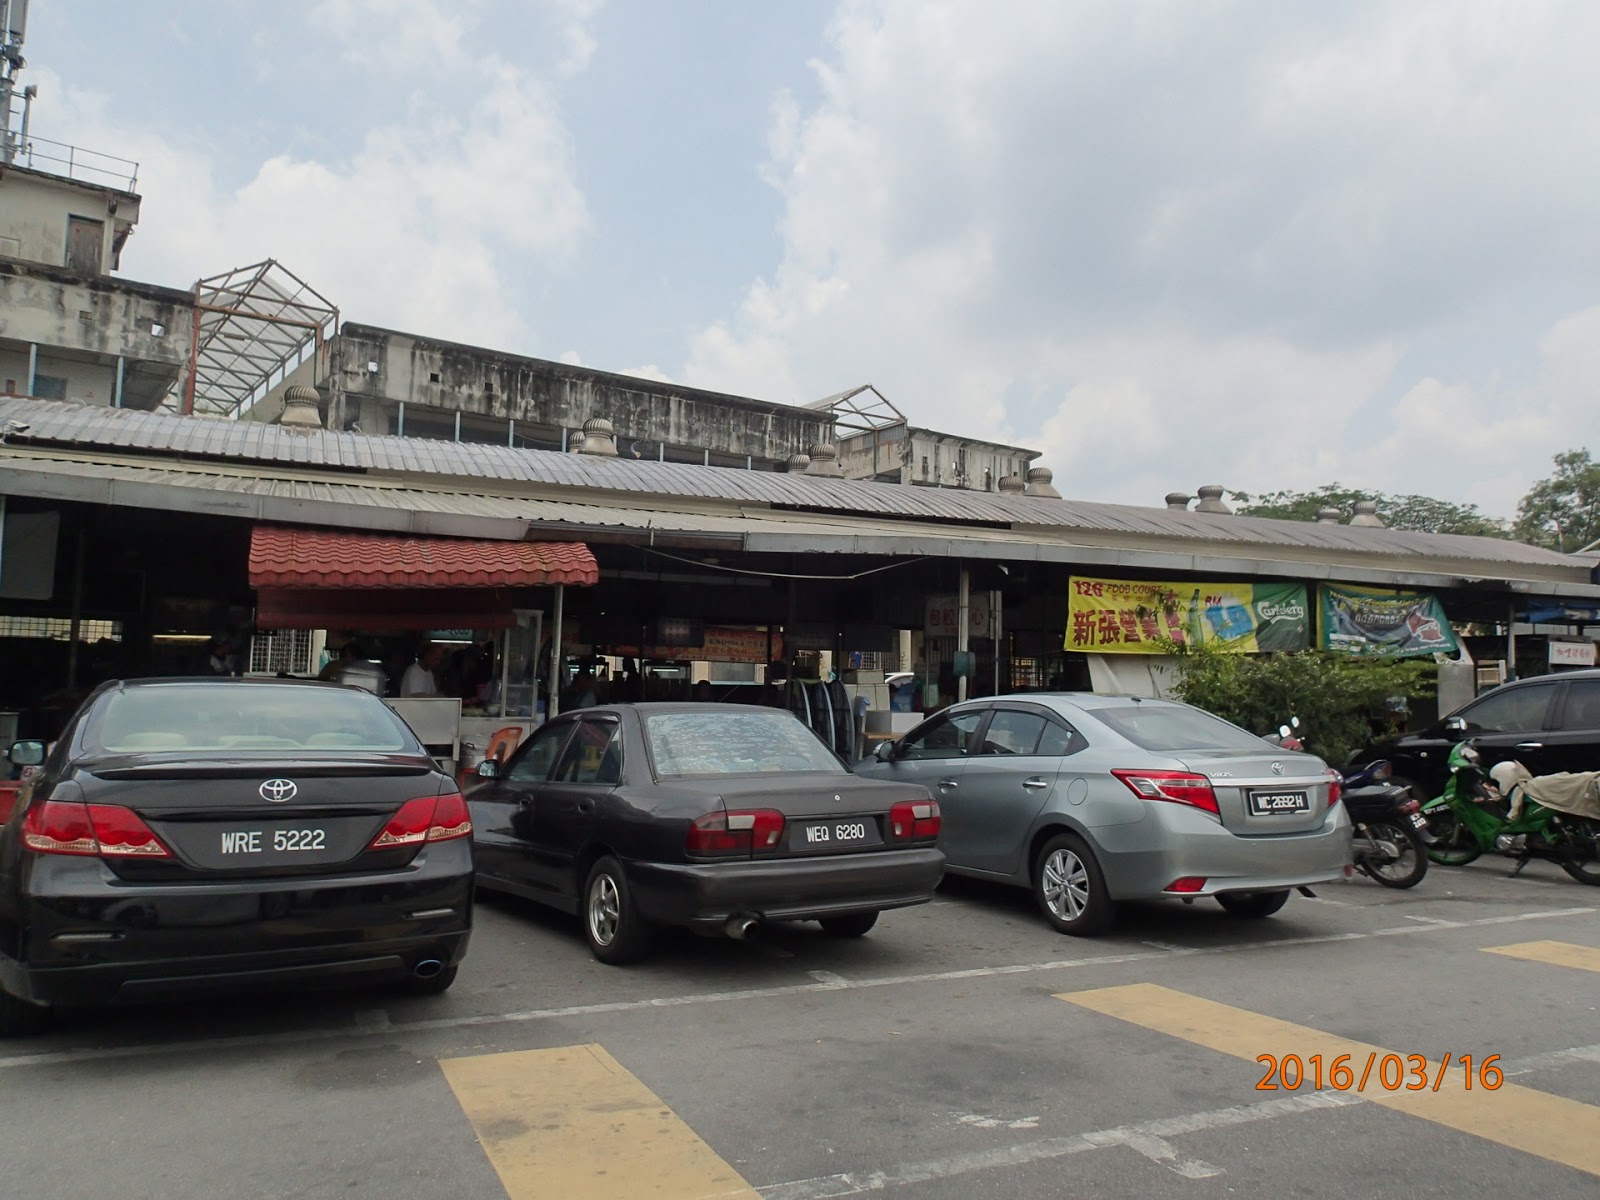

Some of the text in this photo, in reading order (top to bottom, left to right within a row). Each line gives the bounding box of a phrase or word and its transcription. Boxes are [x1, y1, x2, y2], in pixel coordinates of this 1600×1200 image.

[1106, 583, 1131, 594] FOOD
[1132, 585, 1163, 595] COURT
[1257, 600, 1305, 624] Carlsberg
[1295, 795, 1304, 807] H
[221, 829, 326, 854] WRE 5222
[806, 823, 865, 843] WEQ 6280
